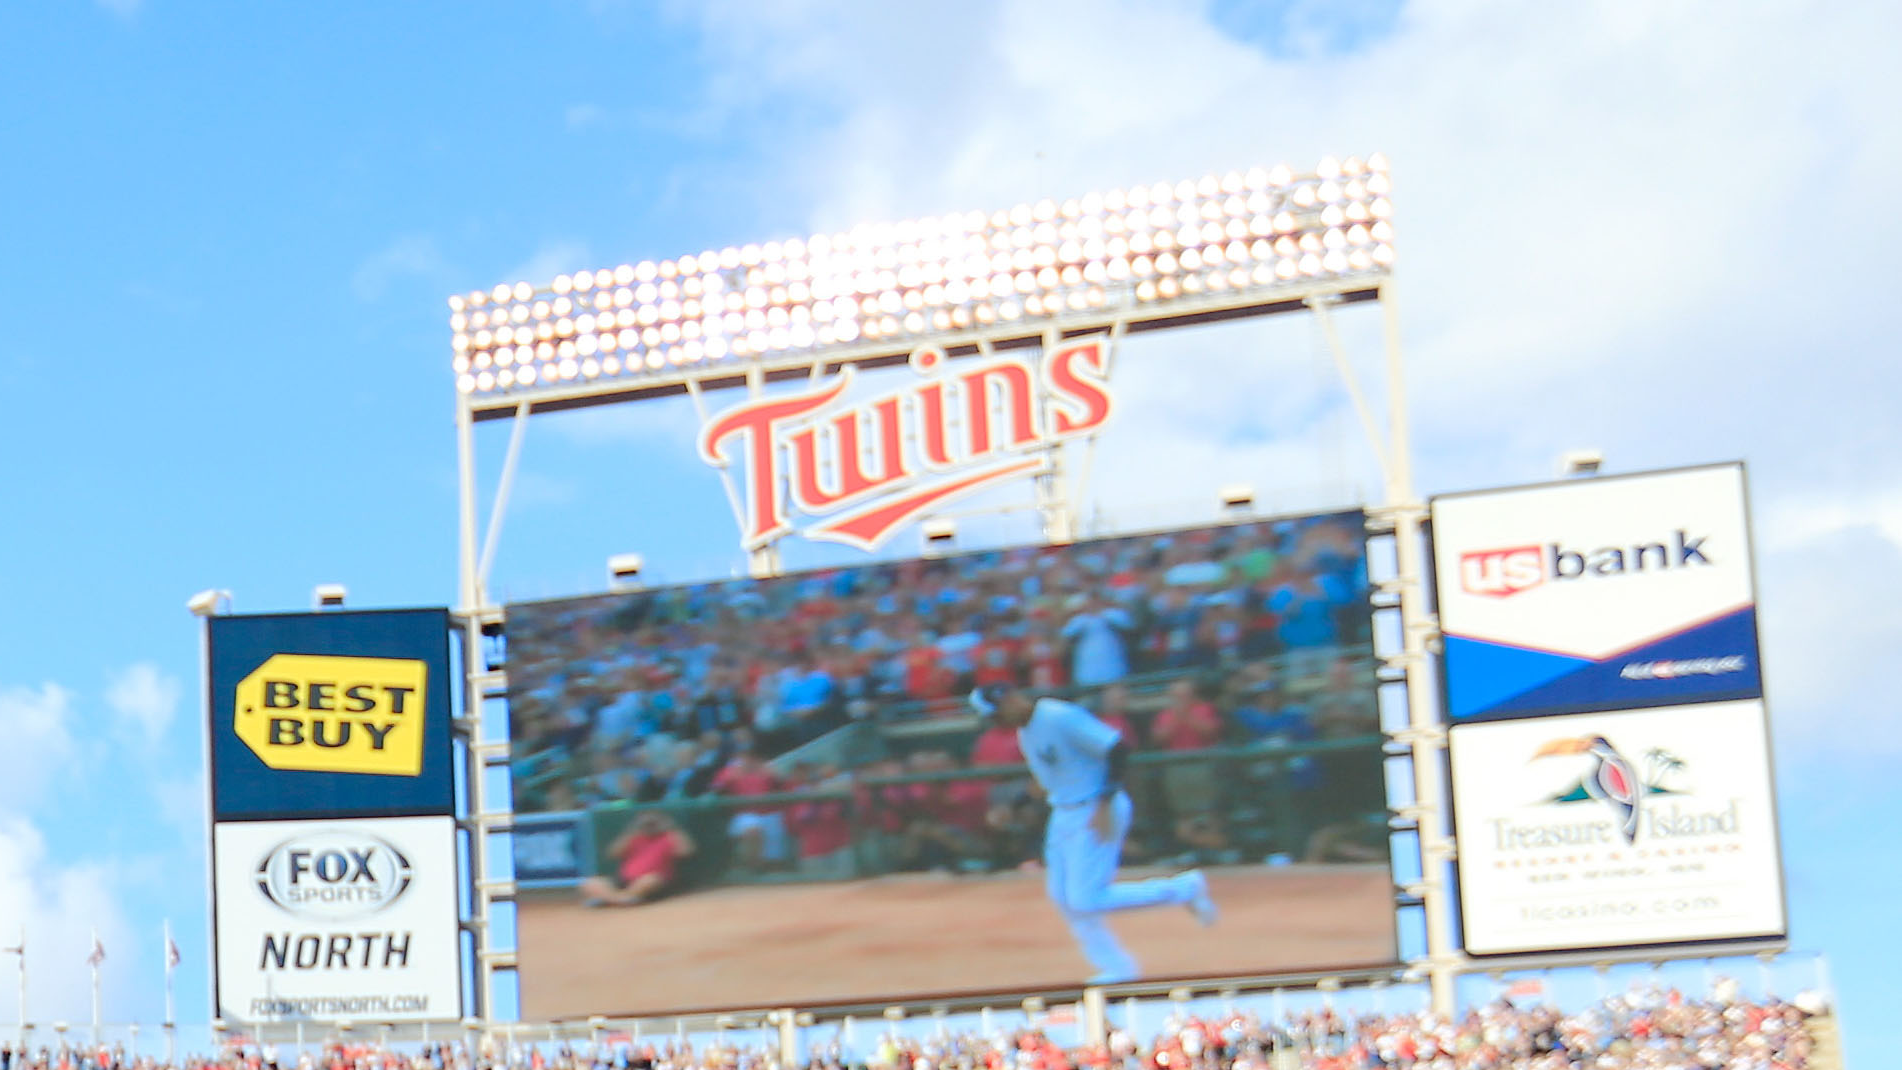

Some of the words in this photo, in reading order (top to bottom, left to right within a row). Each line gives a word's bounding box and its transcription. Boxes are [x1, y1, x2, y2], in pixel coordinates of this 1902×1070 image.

[701, 336, 1112, 548] Twins
[264, 681, 415, 716] BEST
[268, 718, 396, 750] BUY
[1488, 818, 1612, 850] Treasure
[1642, 797, 1742, 839] Island
[289, 848, 377, 884] FOX
[287, 886, 383, 902] SPORTS
[259, 932, 412, 970] NORTH
